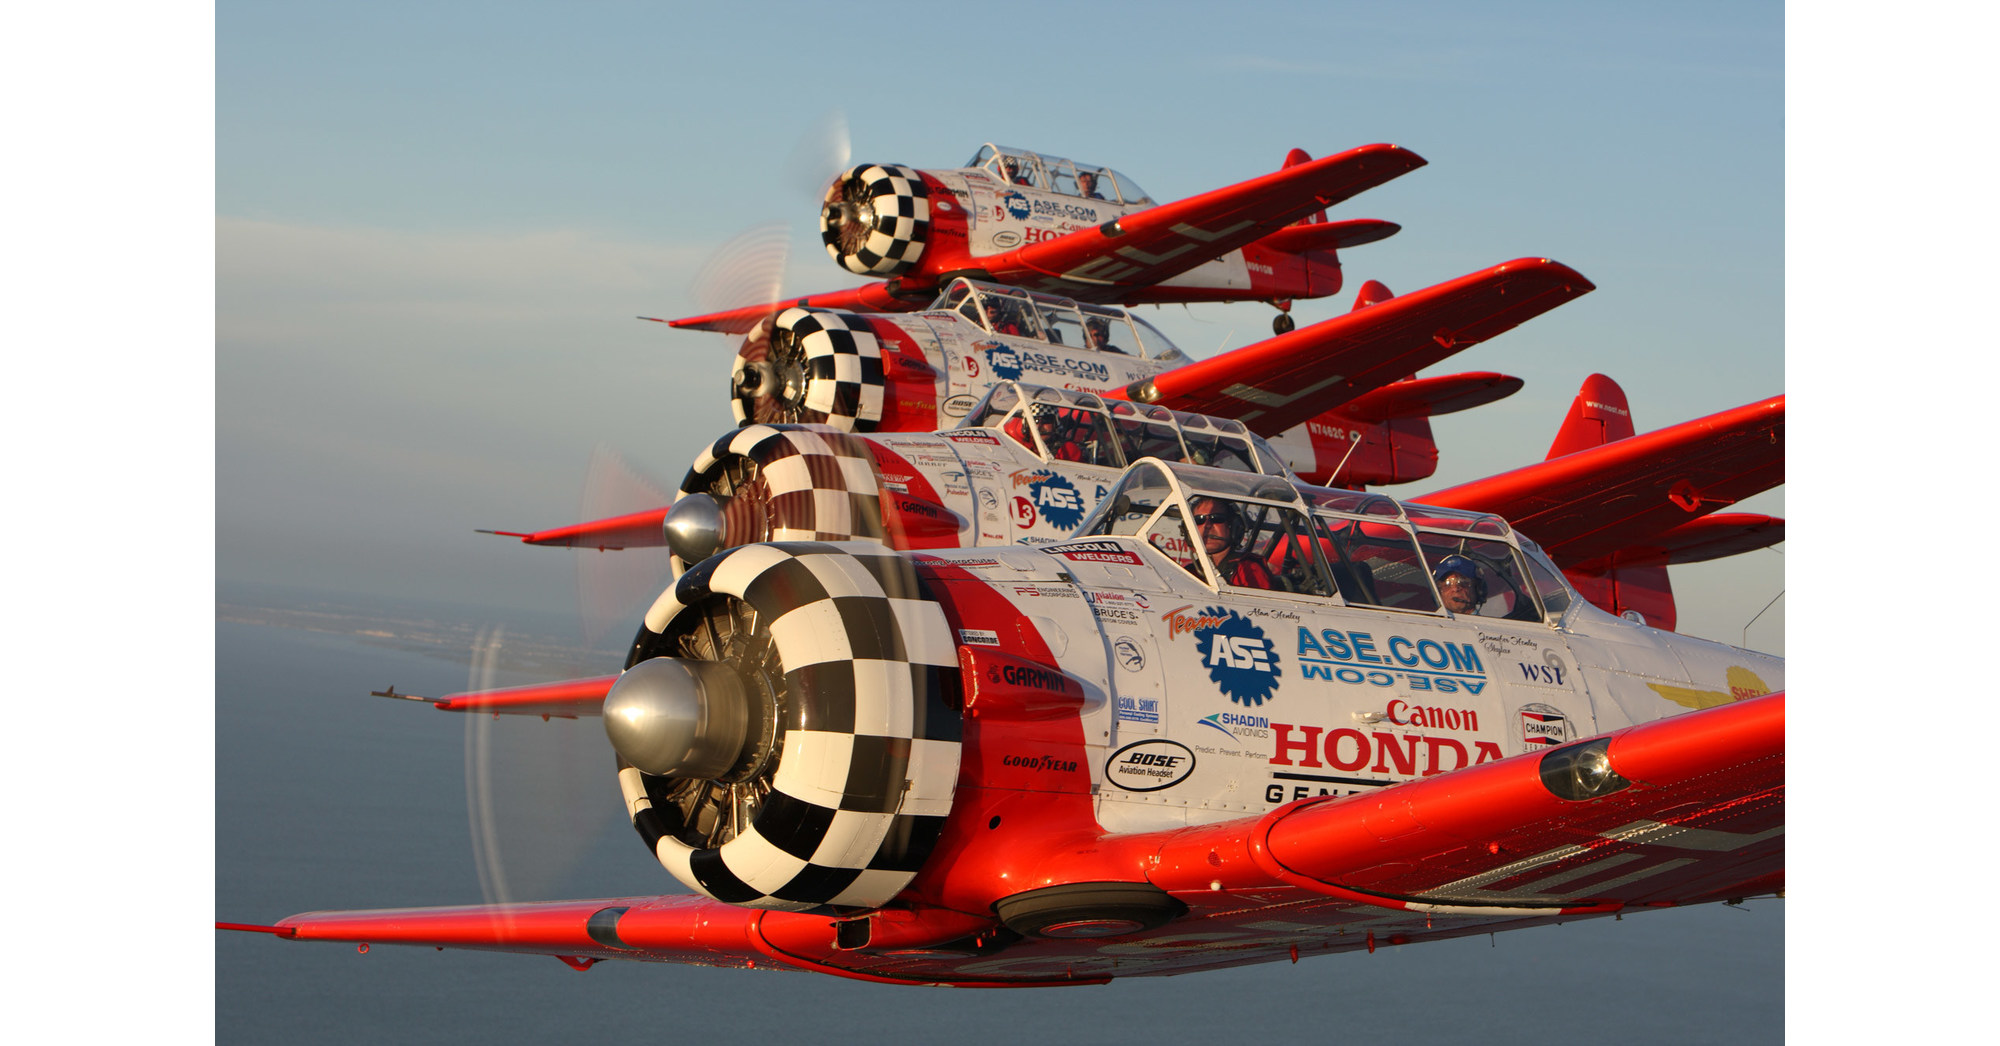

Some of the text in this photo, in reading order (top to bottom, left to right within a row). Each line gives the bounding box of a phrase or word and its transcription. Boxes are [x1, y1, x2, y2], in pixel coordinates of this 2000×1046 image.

[992, 352, 1019, 369] ASE
[1023, 352, 1109, 376] ASE.COM
[1039, 486, 1079, 510] ASE
[902, 502, 938, 518] GARMIN
[1046, 541, 1121, 554] LINCOLN
[1073, 552, 1135, 564] WELDERS
[1247, 607, 1269, 617] Alan
[1162, 604, 1231, 641] Team
[962, 636, 998, 645] CONCORDE
[1210, 634, 1272, 673] ASE
[1297, 625, 1486, 674] ASE.COM
[1003, 665, 1065, 693] GARMIN
[1118, 696, 1159, 713] COOL SHIRT
[1222, 713, 1269, 729] SHADIN
[1386, 699, 1479, 732] Canon
[1232, 726, 1269, 739] AVIONICS
[1525, 722, 1563, 737] CHAMPION
[1269, 721, 1504, 778] HONDA
[1003, 754, 1078, 773] GOODYEAR
[1119, 752, 1186, 768] BOSE
[1118, 765, 1173, 779] Aviation Headset
